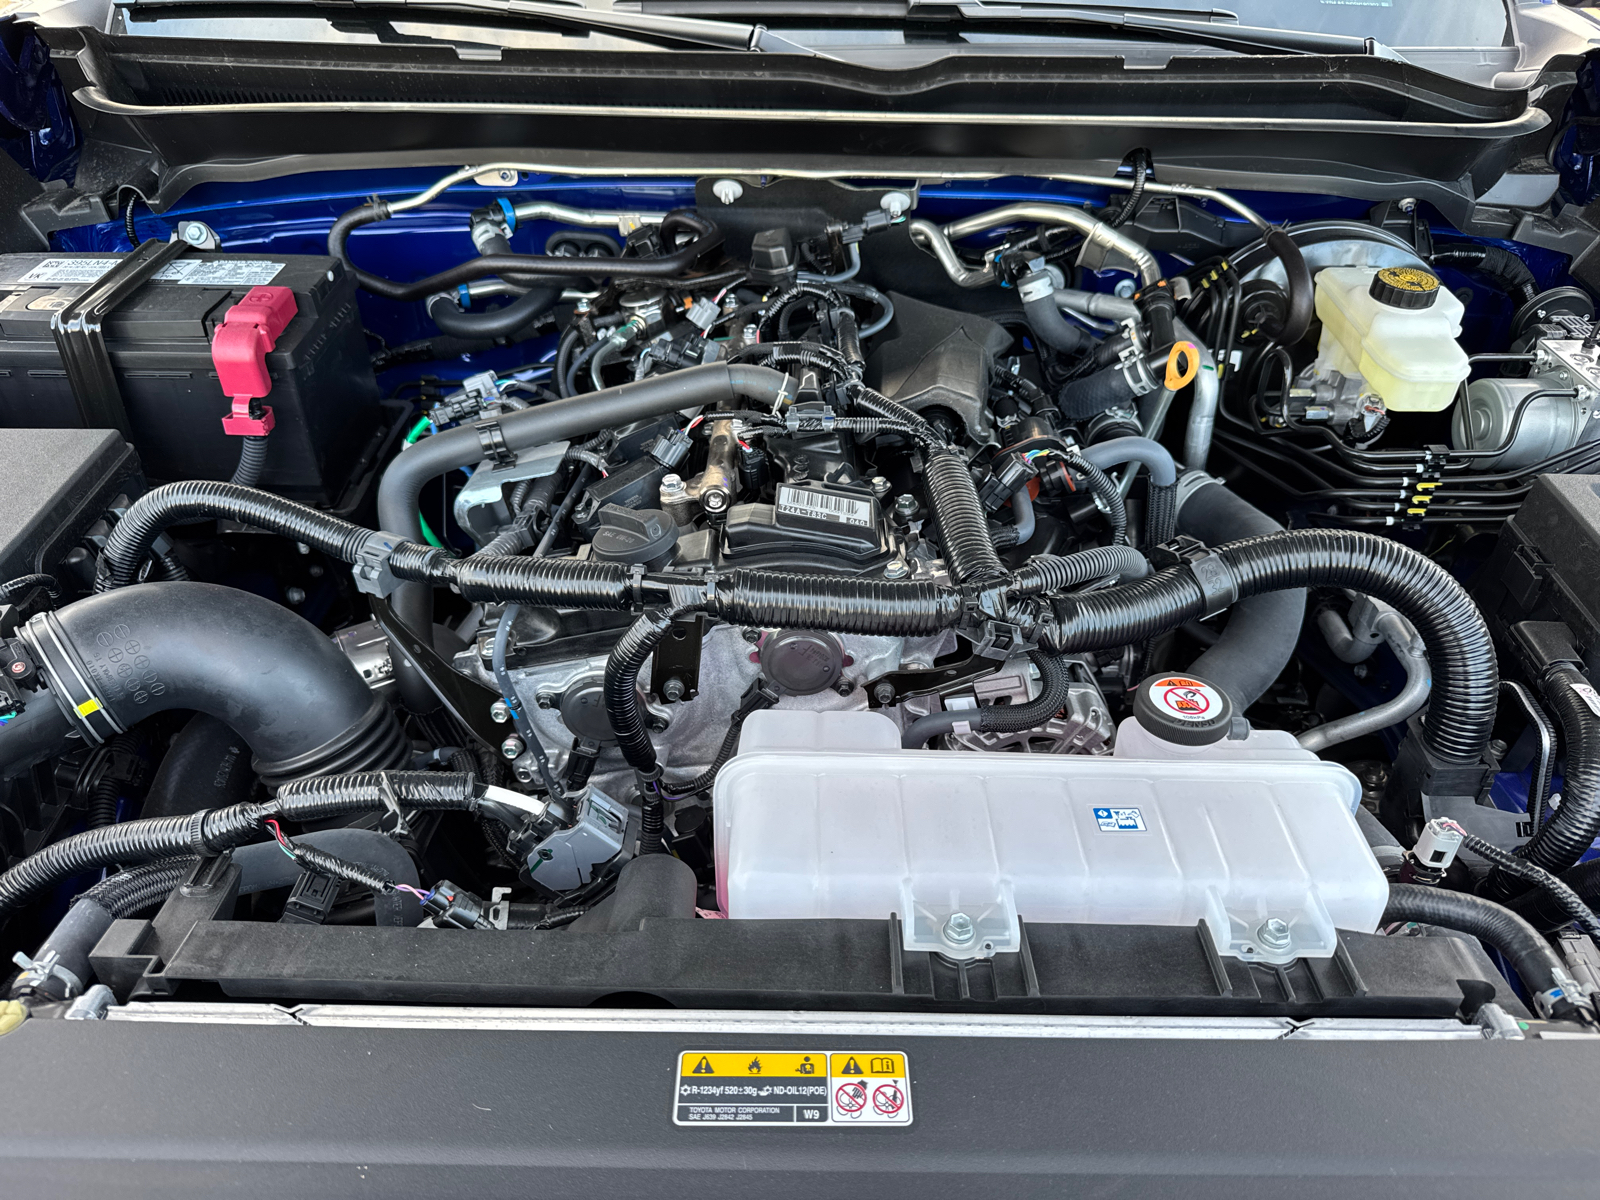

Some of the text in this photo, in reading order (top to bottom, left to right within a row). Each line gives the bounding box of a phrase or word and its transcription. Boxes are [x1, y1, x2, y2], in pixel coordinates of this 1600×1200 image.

[780, 504, 827, 520] T24A-T83C
[692, 1086, 828, 1096] R-1234yf 520±30g ND-OIL12(POE)
[689, 1106, 780, 1114] TOYOTA MOTOR CORPORATION
[803, 1109, 820, 1120] W9
[688, 1113, 700, 1121] SAE
